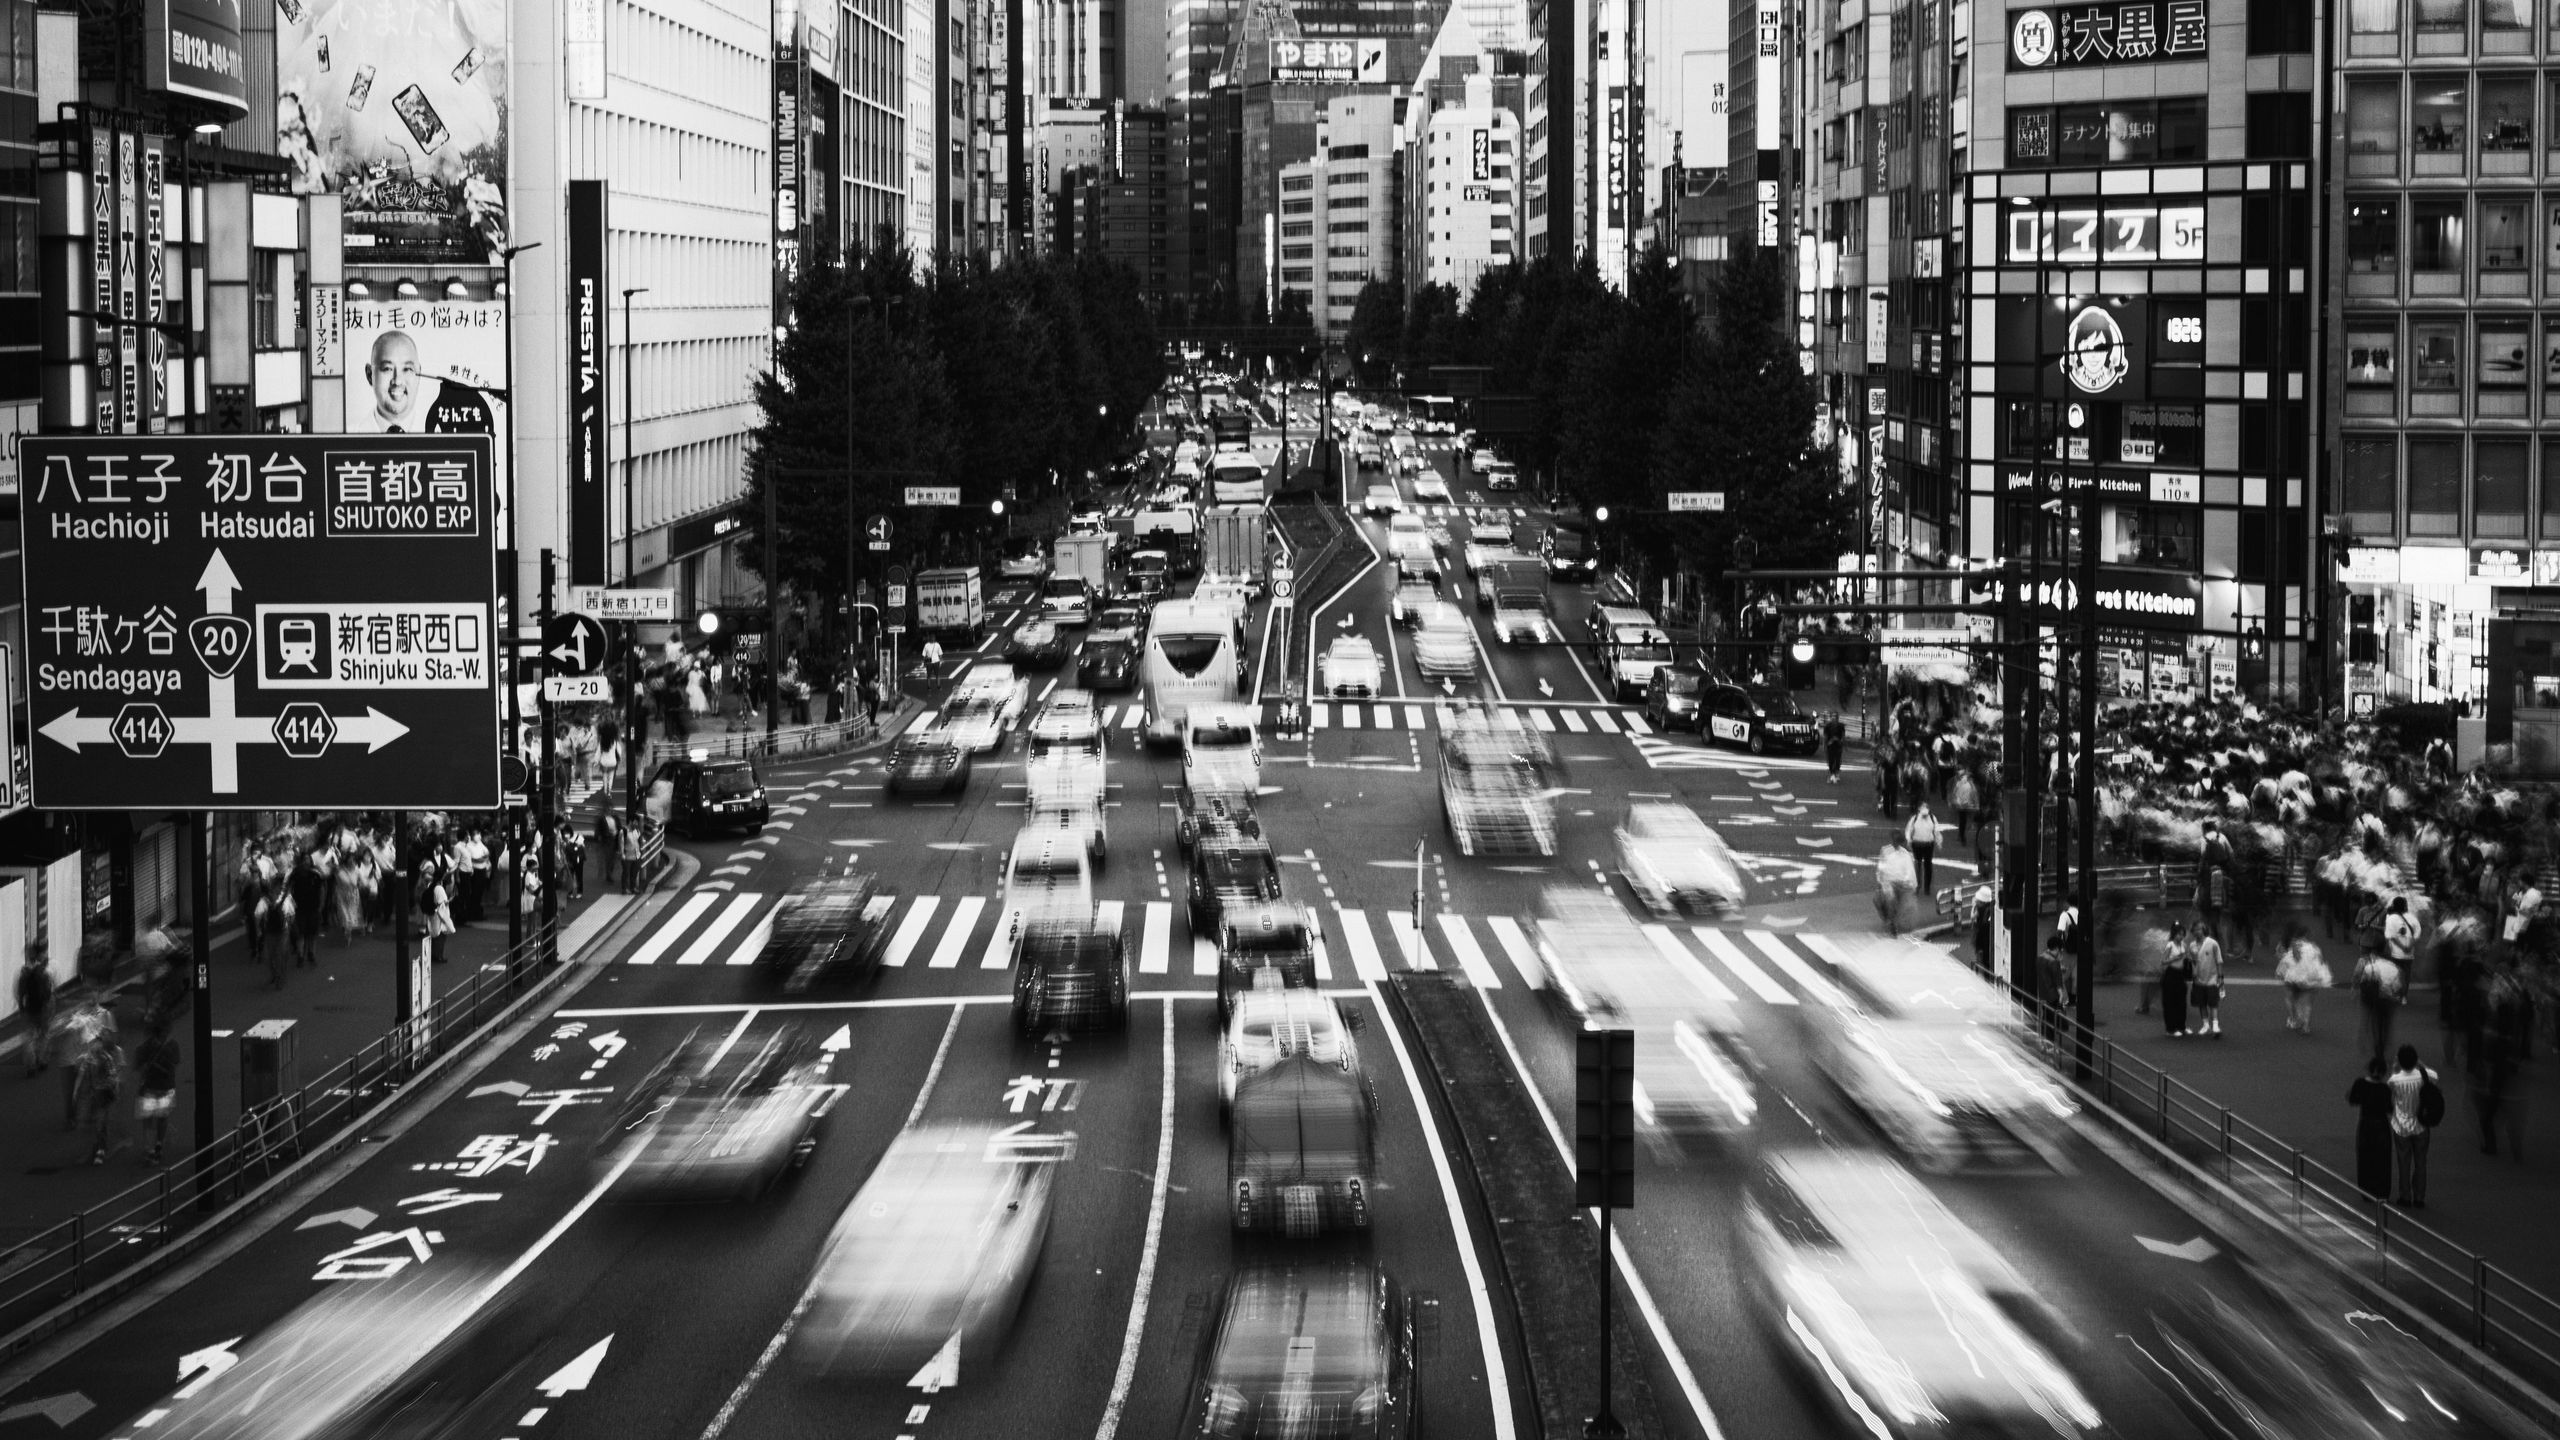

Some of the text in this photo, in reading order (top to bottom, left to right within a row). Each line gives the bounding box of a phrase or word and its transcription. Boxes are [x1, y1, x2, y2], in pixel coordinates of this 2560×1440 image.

[2073, 1, 2206, 62] 大黒屋
[1277, 41, 1353, 67] やまや
[778, 90, 795, 141] JAPAN
[778, 143, 795, 189] TOTAL
[94, 157, 112, 333] 大黒屋
[2174, 218, 2203, 248] 5F
[120, 215, 137, 427] 大黒屋
[345, 306, 502, 330] 抜け毛の悩みは？
[438, 406, 482, 423] なんでも
[37, 451, 469, 504] 八王子 初台 首都高
[2099, 477, 2142, 492] Kitchen
[51, 505, 472, 545] Hachioji Hatsudai SHUTOKO EXP
[586, 597, 668, 610] 西新宿1丁目
[2125, 589, 2196, 616] Kitchen
[203, 625, 238, 657] 20
[337, 612, 480, 656] 新宿駅西口
[1895, 650, 1948, 660] Nishishinjuku
[39, 658, 482, 696] Sendagaya Shinjuku Sta.-W.
[554, 682, 598, 696] 7-20
[121, 717, 163, 742] 414
[284, 717, 325, 742] 414
